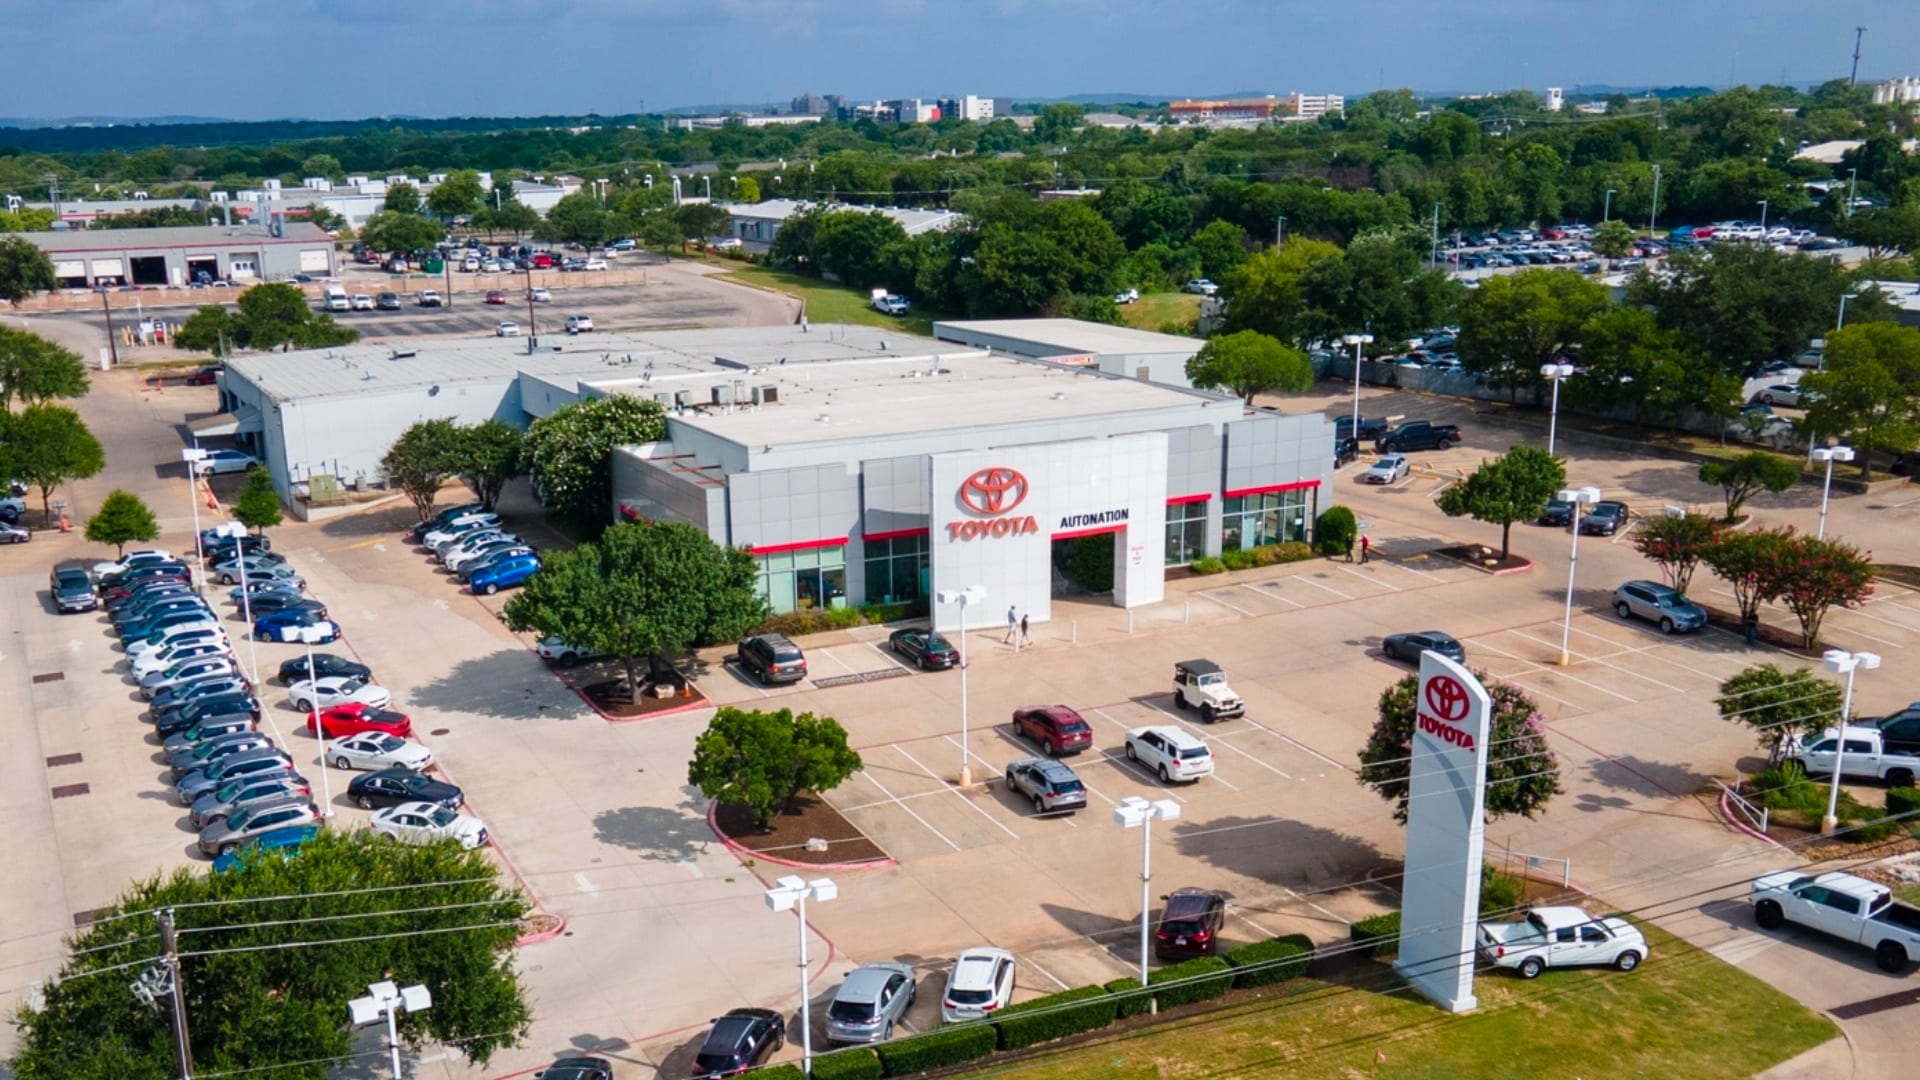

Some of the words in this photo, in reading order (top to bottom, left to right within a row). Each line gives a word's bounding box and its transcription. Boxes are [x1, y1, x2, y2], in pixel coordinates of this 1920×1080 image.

[949, 515, 1039, 540] TOYOTA
[1060, 508, 1129, 528] AUTONATION
[1418, 712, 1475, 752] TOYOTA
